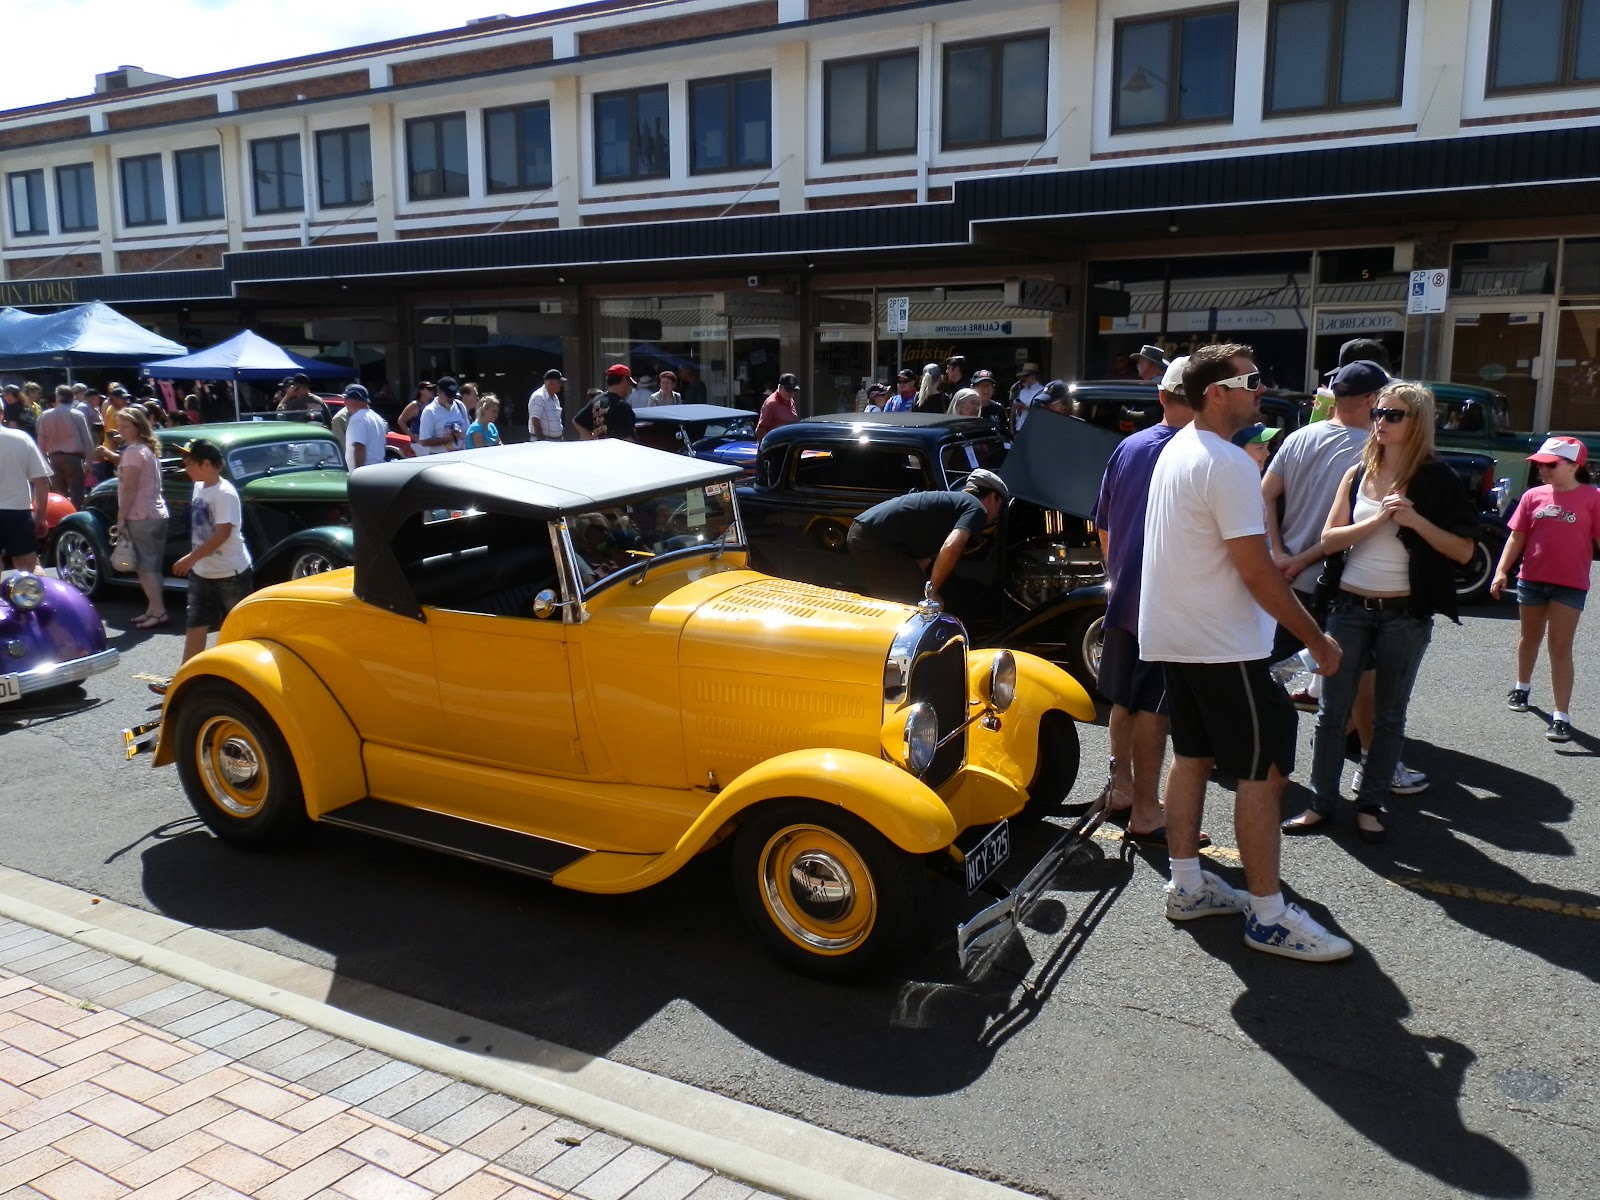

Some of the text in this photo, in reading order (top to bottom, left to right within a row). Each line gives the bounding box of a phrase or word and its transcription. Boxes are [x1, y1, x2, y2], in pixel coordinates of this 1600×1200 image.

[1362, 269, 1369, 279] 5
[1412, 271, 1426, 282] 2P
[28, 281, 77, 303] HOUSE
[1477, 288, 1507, 297] DUGGAN
[889, 299, 897, 309] 2P
